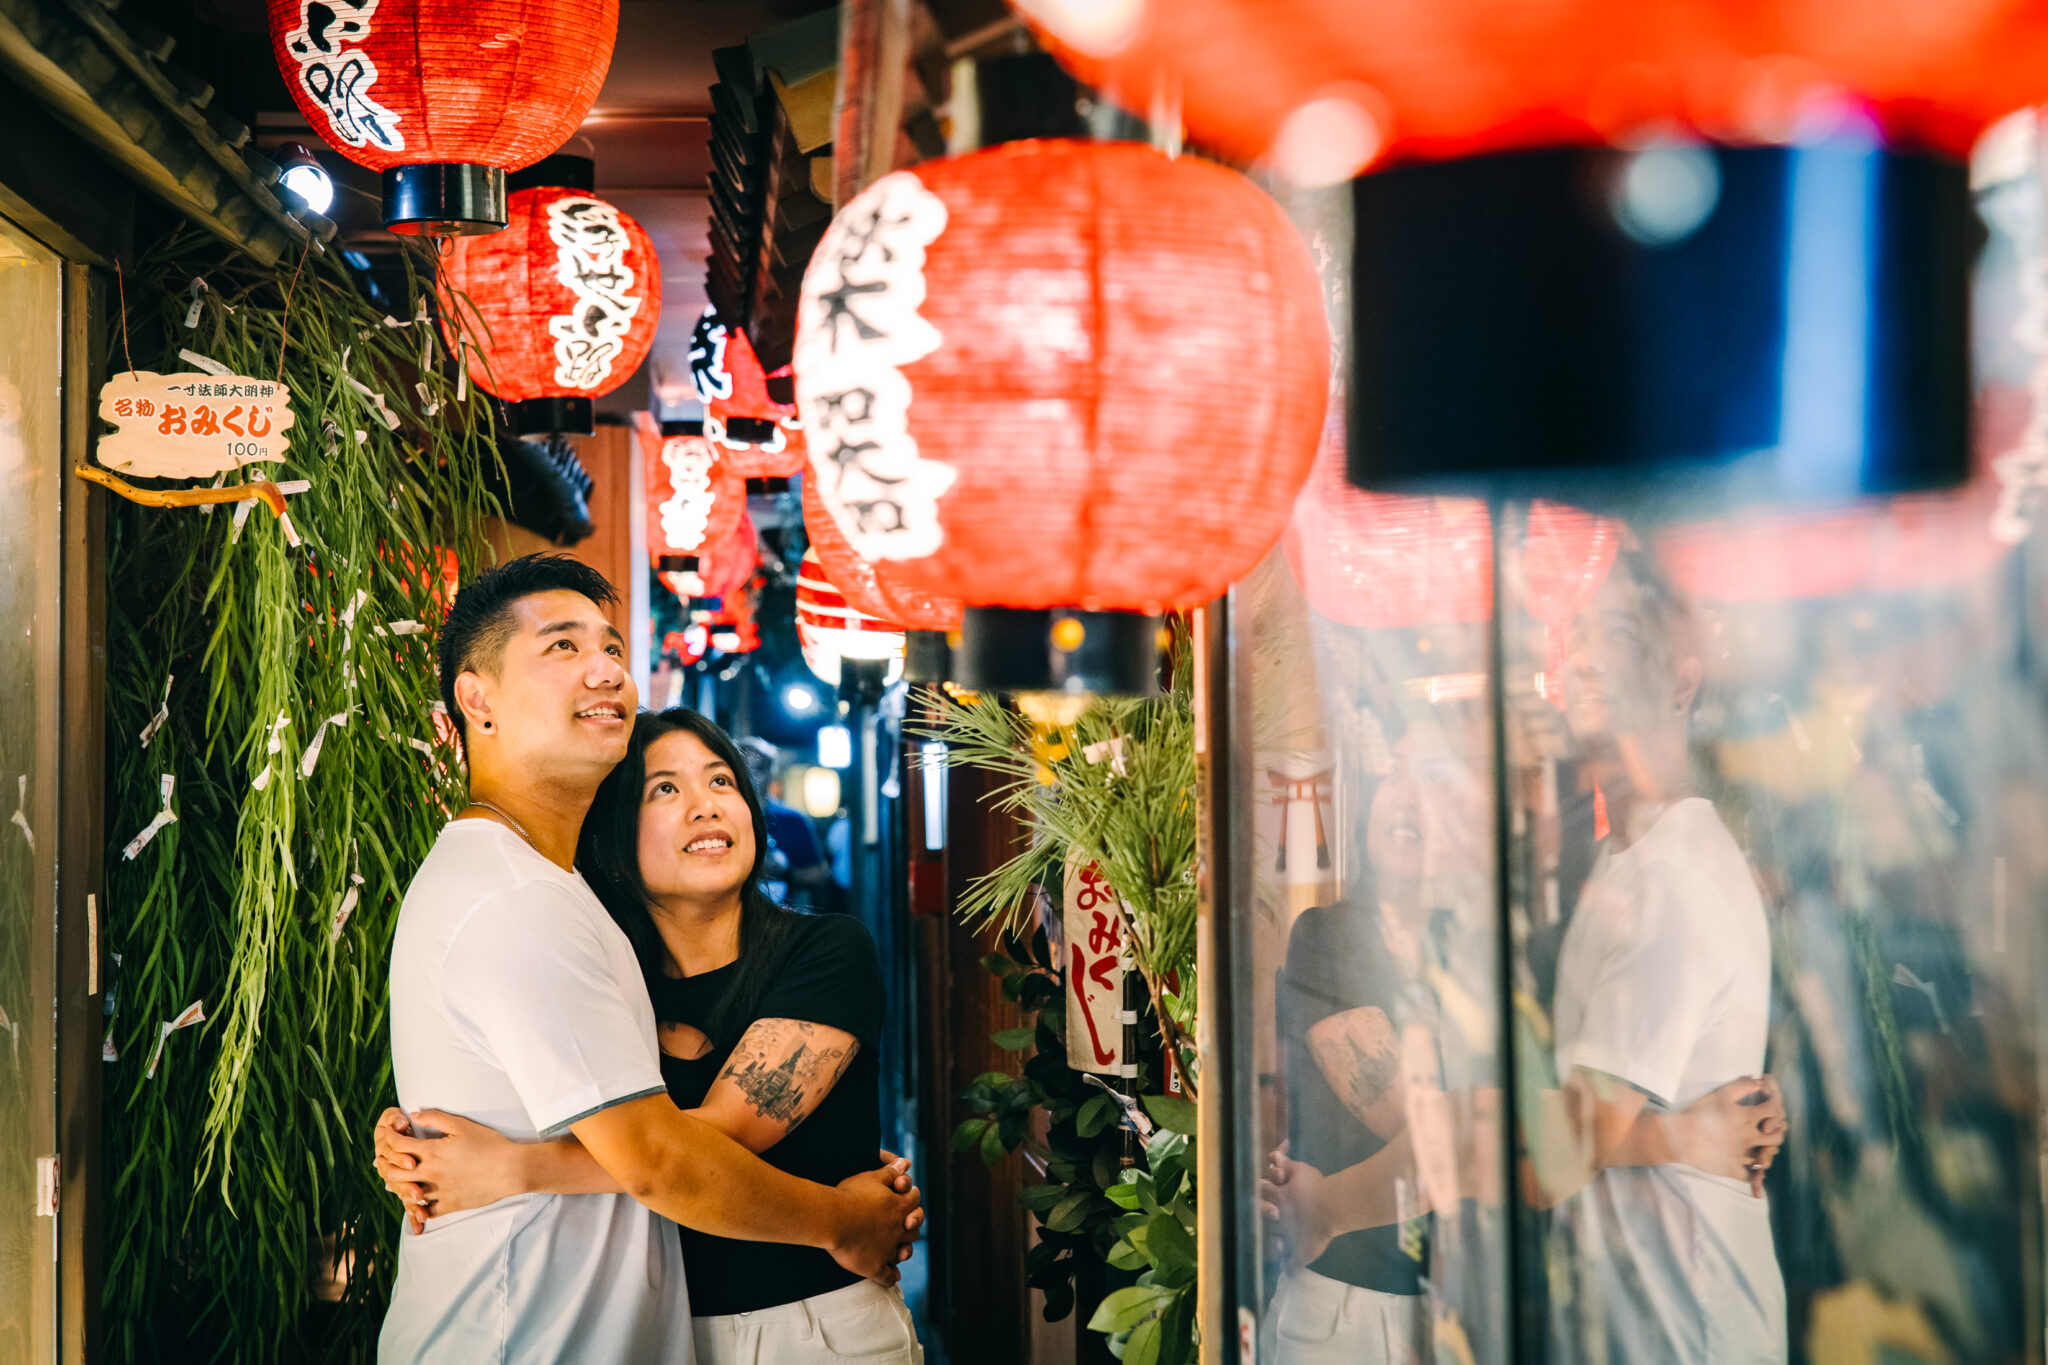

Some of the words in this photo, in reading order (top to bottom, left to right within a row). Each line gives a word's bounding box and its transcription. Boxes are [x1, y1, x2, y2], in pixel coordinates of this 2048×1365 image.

[167, 383, 274, 398] 一寸法師大明神
[114, 399, 155, 417] 名物
[158, 404, 273, 438] おみくじ
[227, 442, 268, 456] 100円
[1071, 859, 1123, 1066] おみくじ
